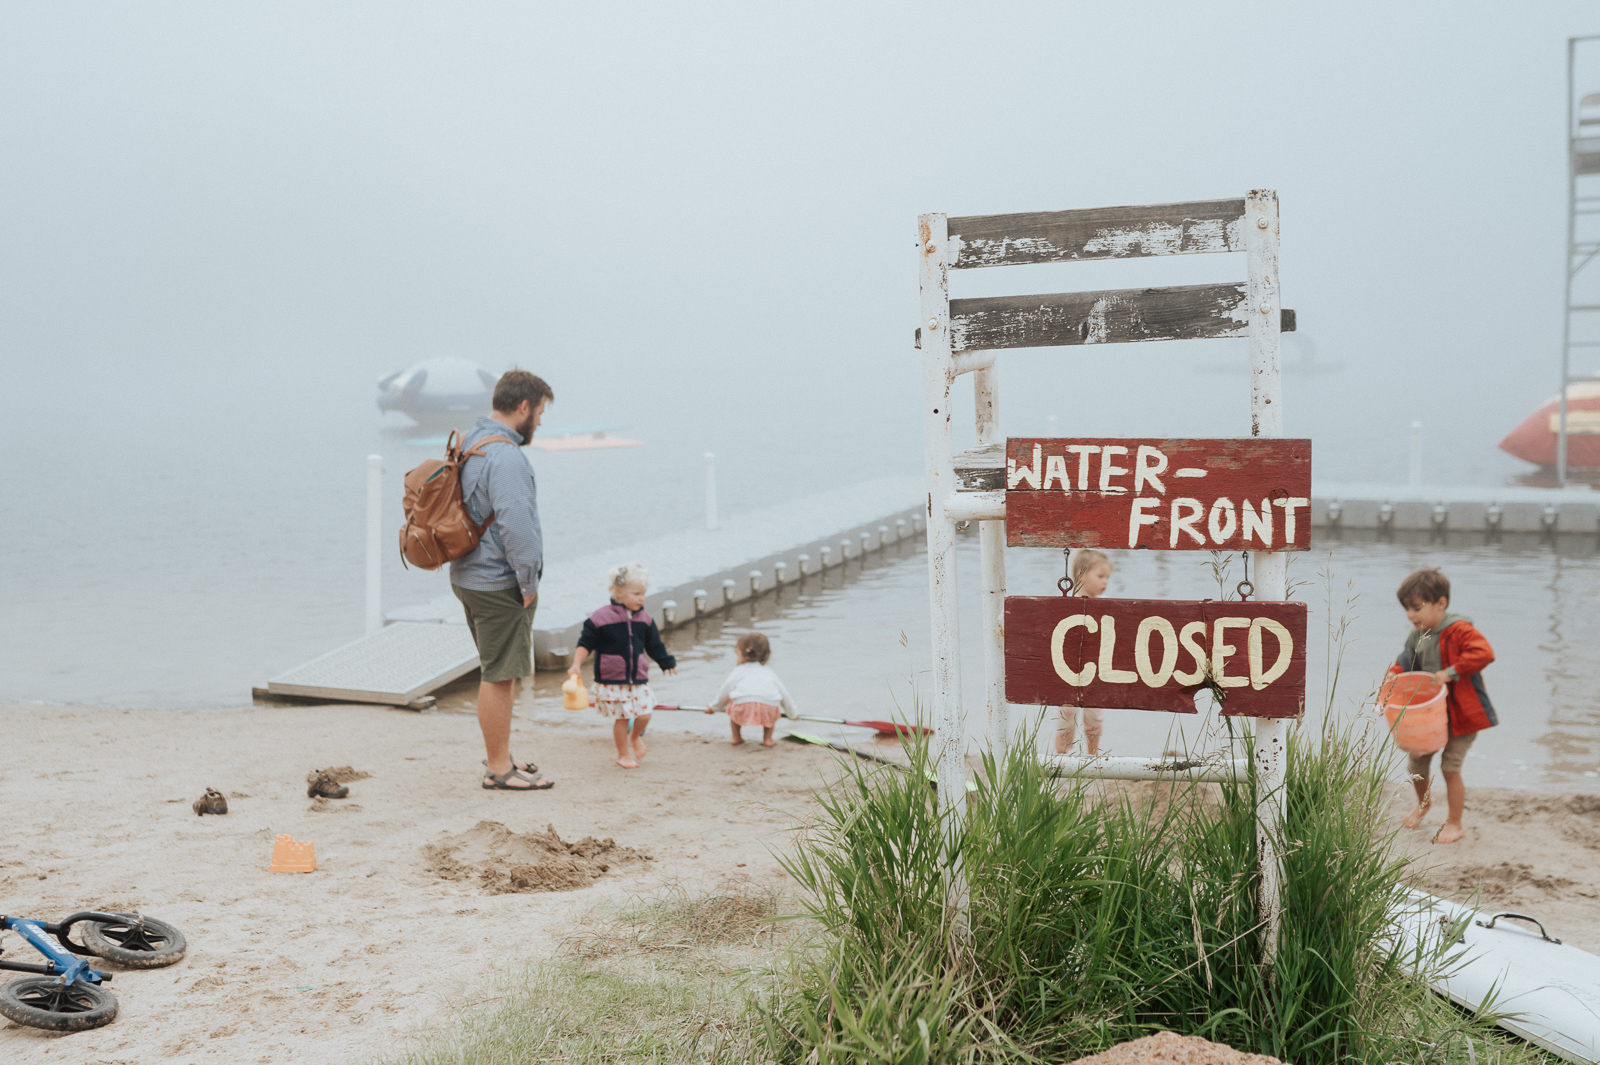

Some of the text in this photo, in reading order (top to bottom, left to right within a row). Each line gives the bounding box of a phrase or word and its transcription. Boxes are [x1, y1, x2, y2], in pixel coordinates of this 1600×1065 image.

[1007, 443, 1208, 495] WATER-
[1128, 497, 1309, 548] FRONT
[1050, 614, 1294, 690] CLOSED
